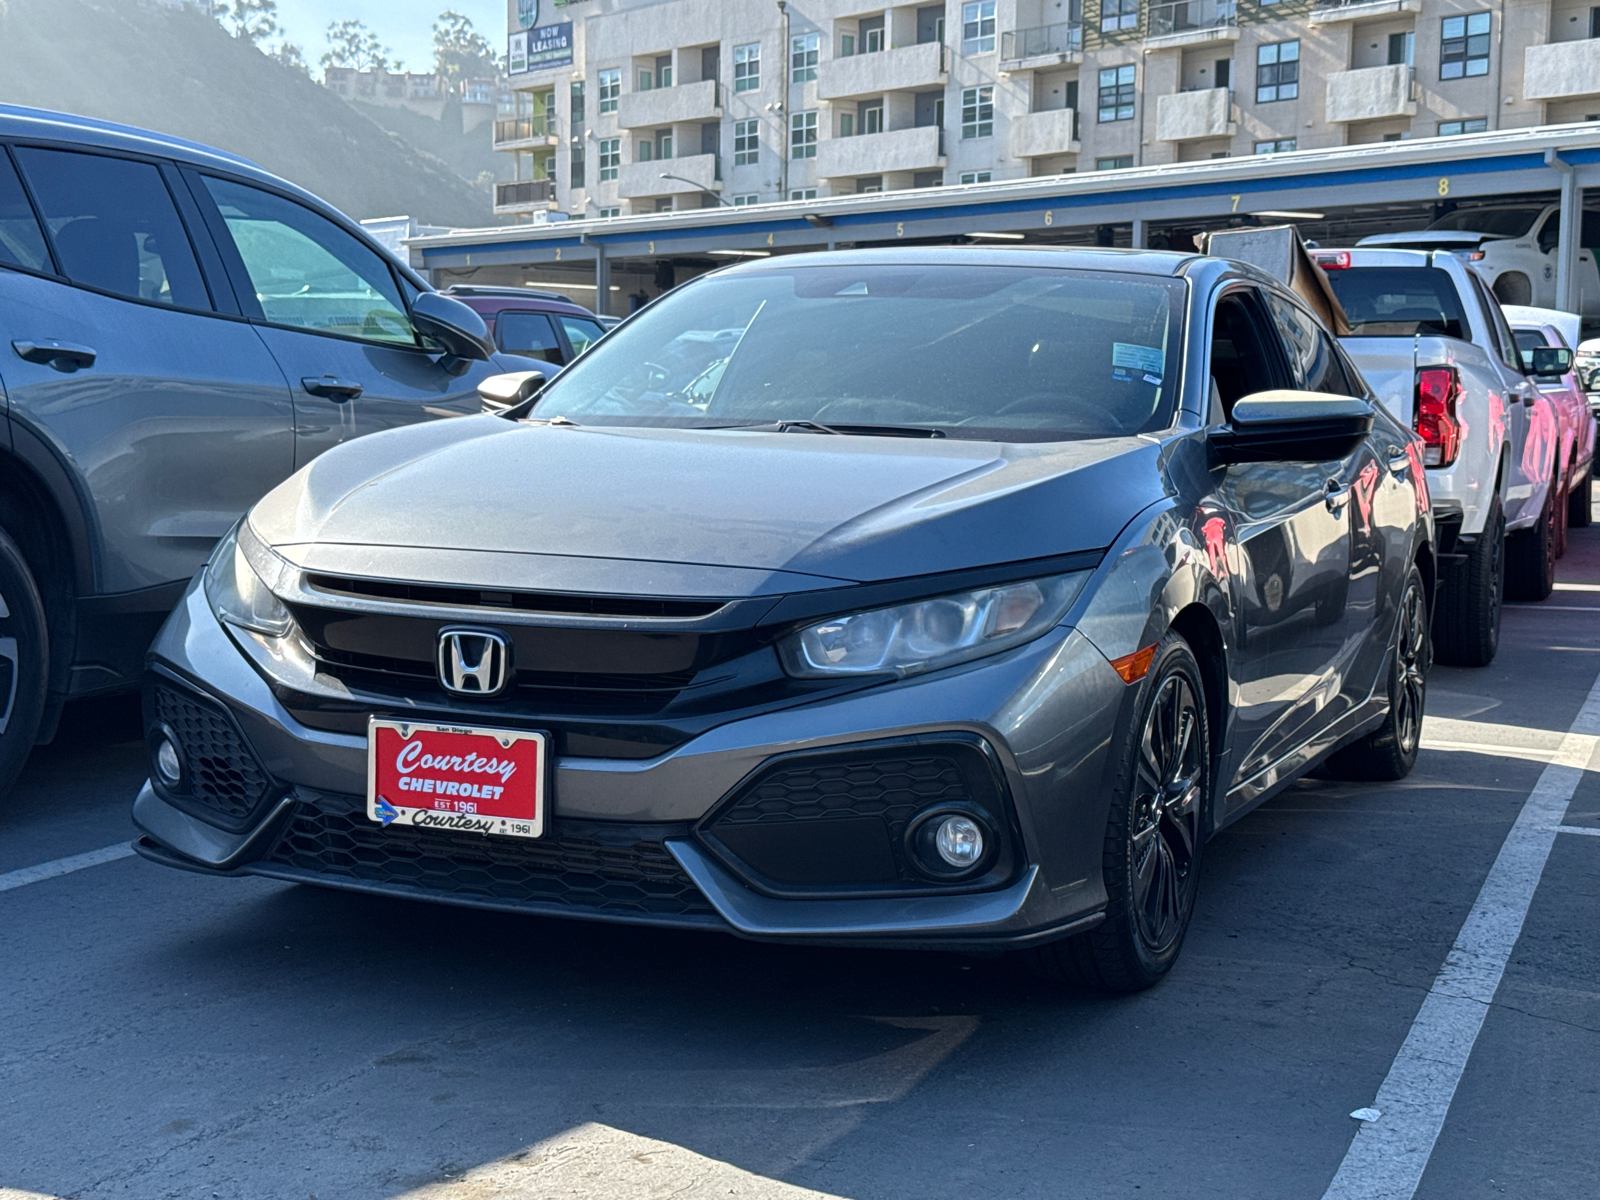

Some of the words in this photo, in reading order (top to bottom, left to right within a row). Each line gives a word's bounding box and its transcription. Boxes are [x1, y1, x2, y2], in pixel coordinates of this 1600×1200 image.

[540, 26, 560, 39] NOW
[532, 36, 567, 53] LEASING
[1438, 177, 1449, 196] 8
[1231, 195, 1241, 213] 7
[1044, 210, 1053, 226] 6
[896, 222, 904, 236] 5
[767, 233, 774, 246] 4
[556, 248, 562, 260] 2
[649, 242, 655, 254] 3
[466, 254, 470, 266] 1
[451, 727, 473, 735] Diego
[396, 740, 517, 783] Courtesy
[398, 777, 504, 800] CHEVROLET
[434, 801, 451, 809] EST
[453, 801, 478, 814] 1961
[412, 808, 495, 836] Courtesy
[510, 823, 531, 835] 1961
